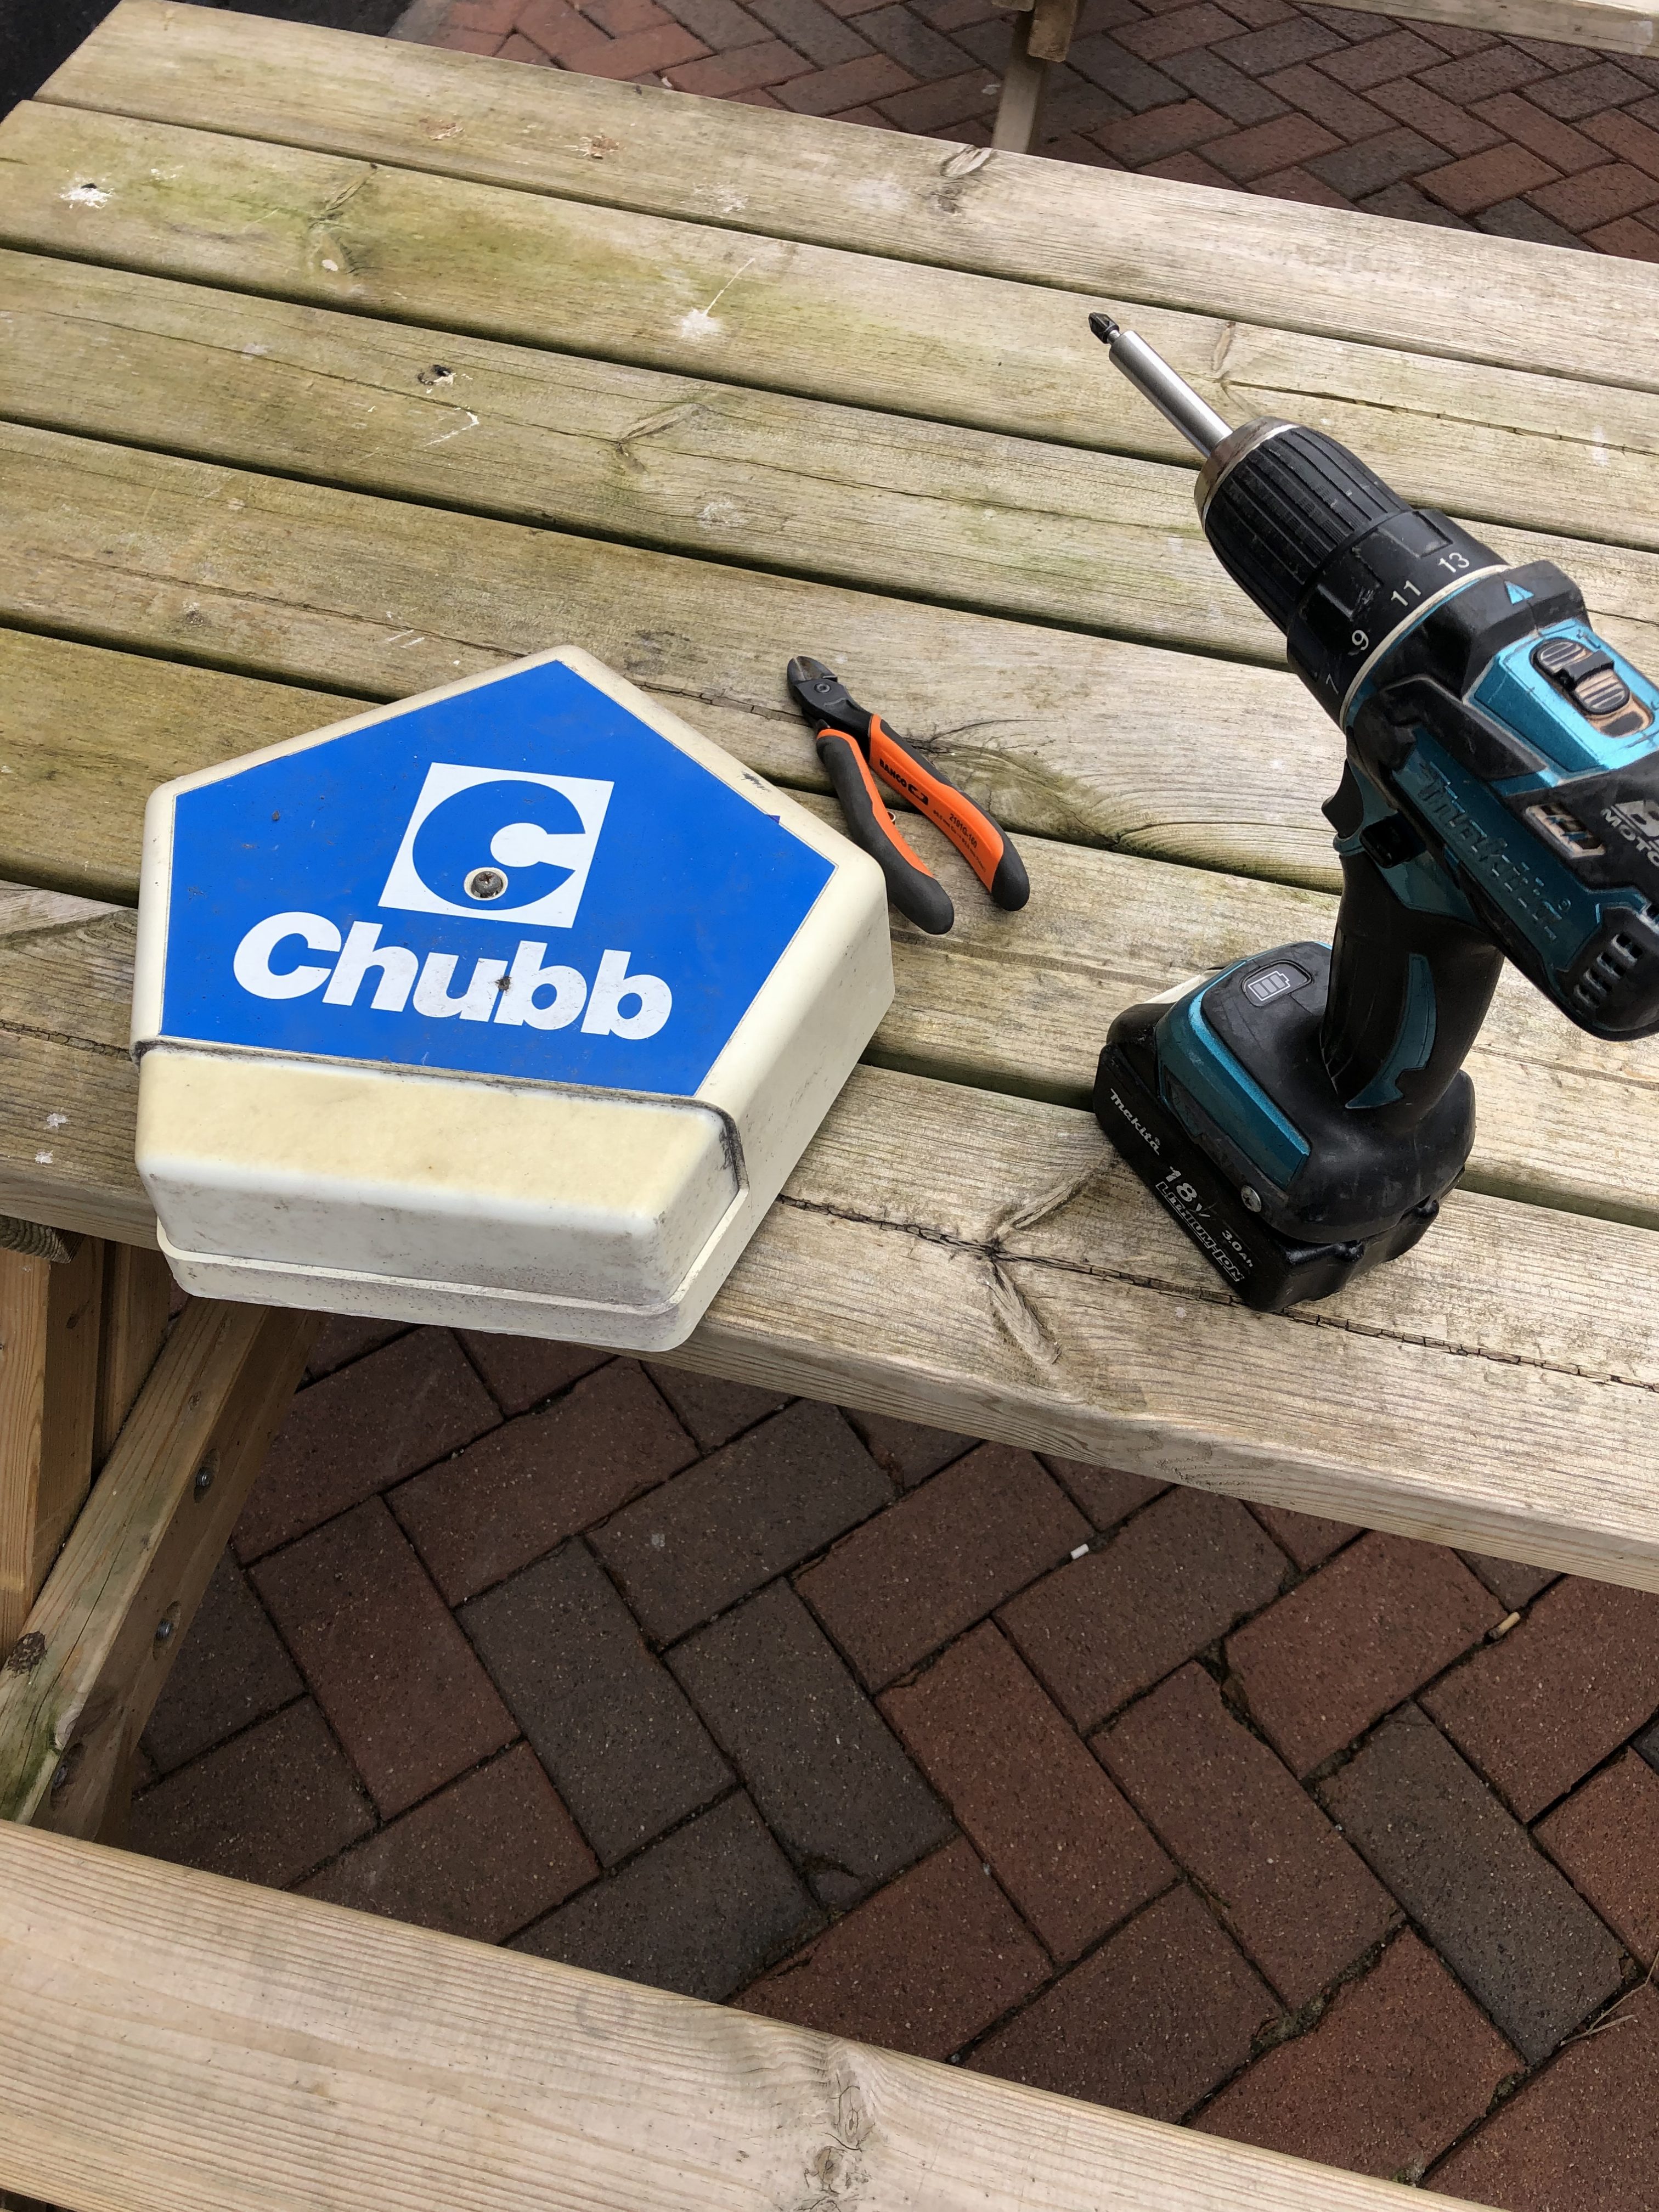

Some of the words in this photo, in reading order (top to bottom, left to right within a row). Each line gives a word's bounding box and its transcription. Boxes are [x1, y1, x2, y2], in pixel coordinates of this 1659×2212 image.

[1438, 552, 1470, 573] 13
[1391, 579, 1422, 607] 11
[1351, 629, 1369, 651] 9
[1325, 673, 1339, 695] 7
[879, 758, 907, 788] BAHCO
[233, 911, 673, 1040] Chubb
[1155, 1181, 1245, 1282] LITHIUM-ION
[1222, 1230, 1254, 1268] 3.0Ah
